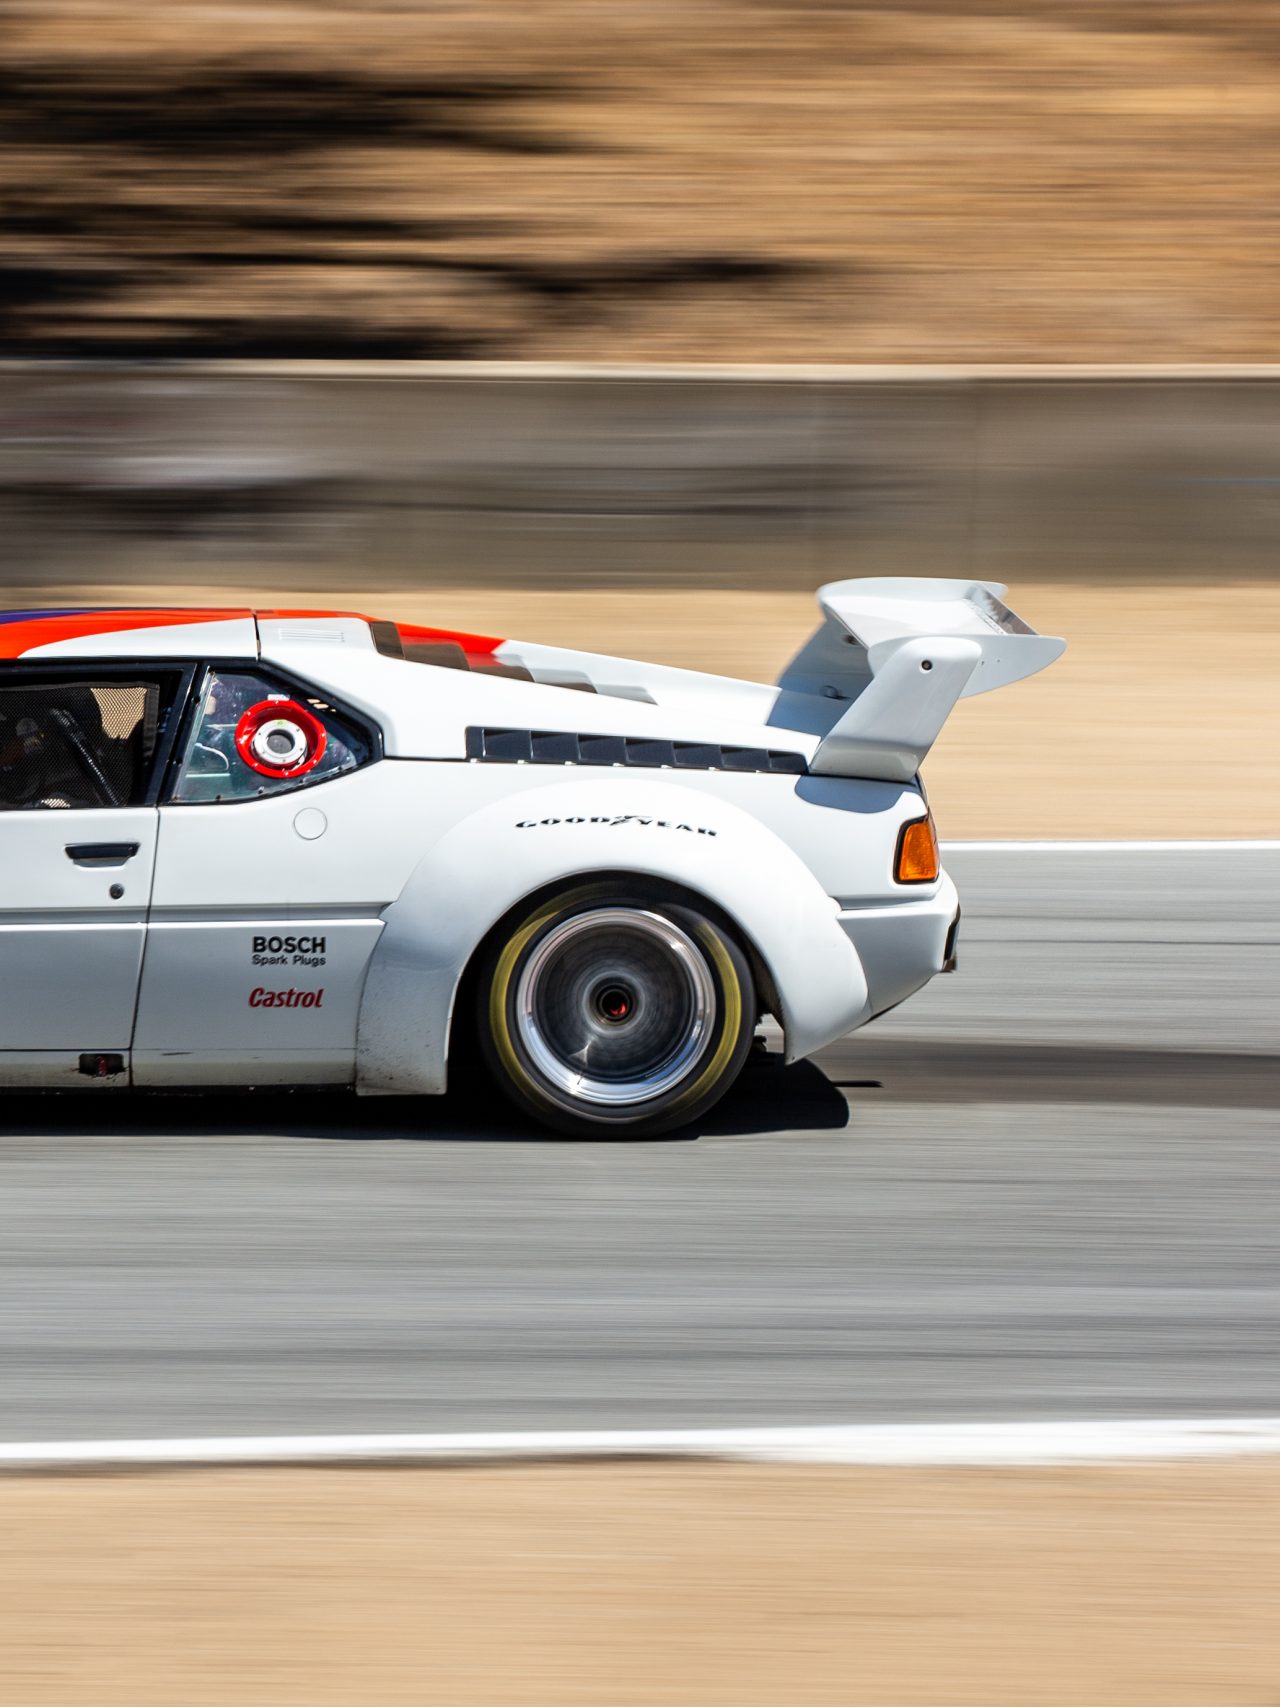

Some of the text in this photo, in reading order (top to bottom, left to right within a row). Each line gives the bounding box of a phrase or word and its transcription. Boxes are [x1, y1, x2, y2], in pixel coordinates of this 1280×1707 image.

[252, 936, 326, 953] BOSCH
[252, 954, 326, 968] Spark Plugs
[248, 987, 324, 1008] Castrol
